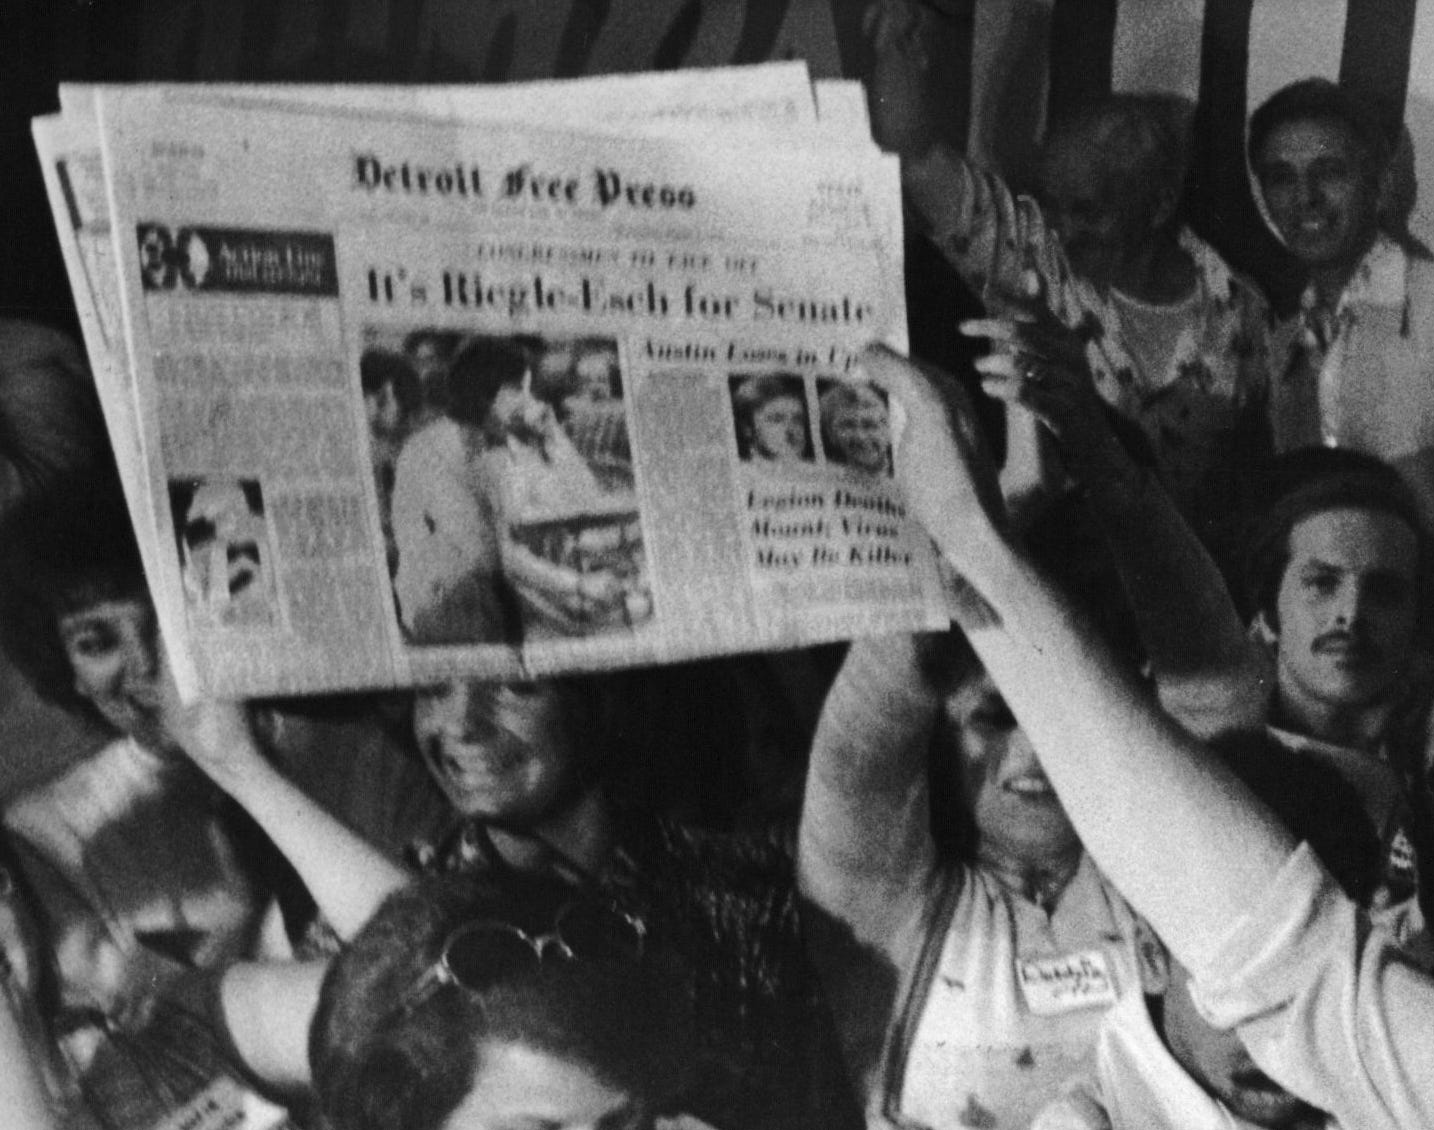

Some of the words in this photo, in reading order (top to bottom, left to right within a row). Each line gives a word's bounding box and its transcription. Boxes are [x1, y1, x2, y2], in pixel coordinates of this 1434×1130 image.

[353, 152, 484, 197] Detroit
[502, 159, 580, 204] Free
[595, 168, 697, 209] Press
[366, 266, 428, 303] It's
[441, 270, 670, 318] Riegle-Esch
[683, 283, 742, 320] for
[751, 289, 873, 325] Senate
